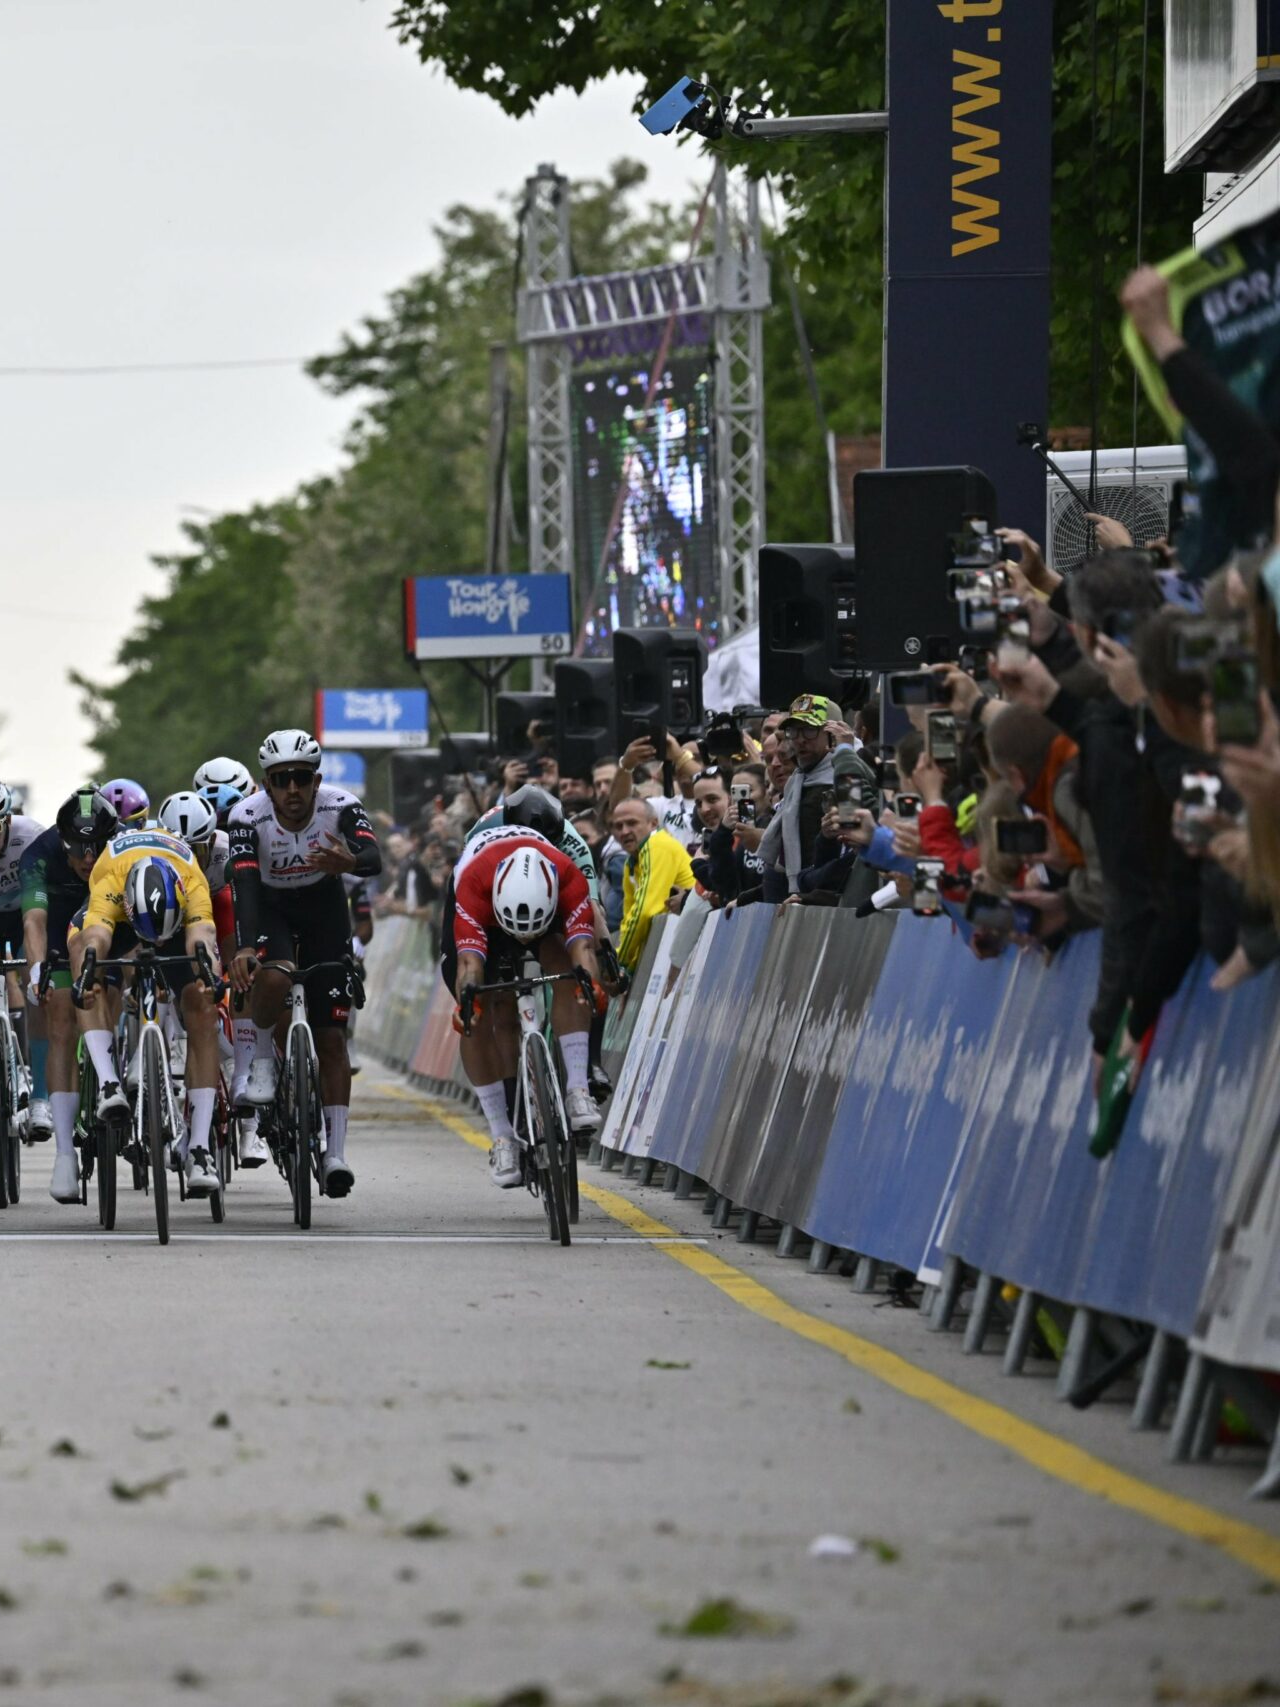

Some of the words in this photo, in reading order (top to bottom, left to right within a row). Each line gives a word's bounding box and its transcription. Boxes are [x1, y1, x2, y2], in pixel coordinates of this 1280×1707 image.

[446, 579, 496, 598] Tour
[540, 634, 565, 651] 50
[271, 854, 306, 870] UA
